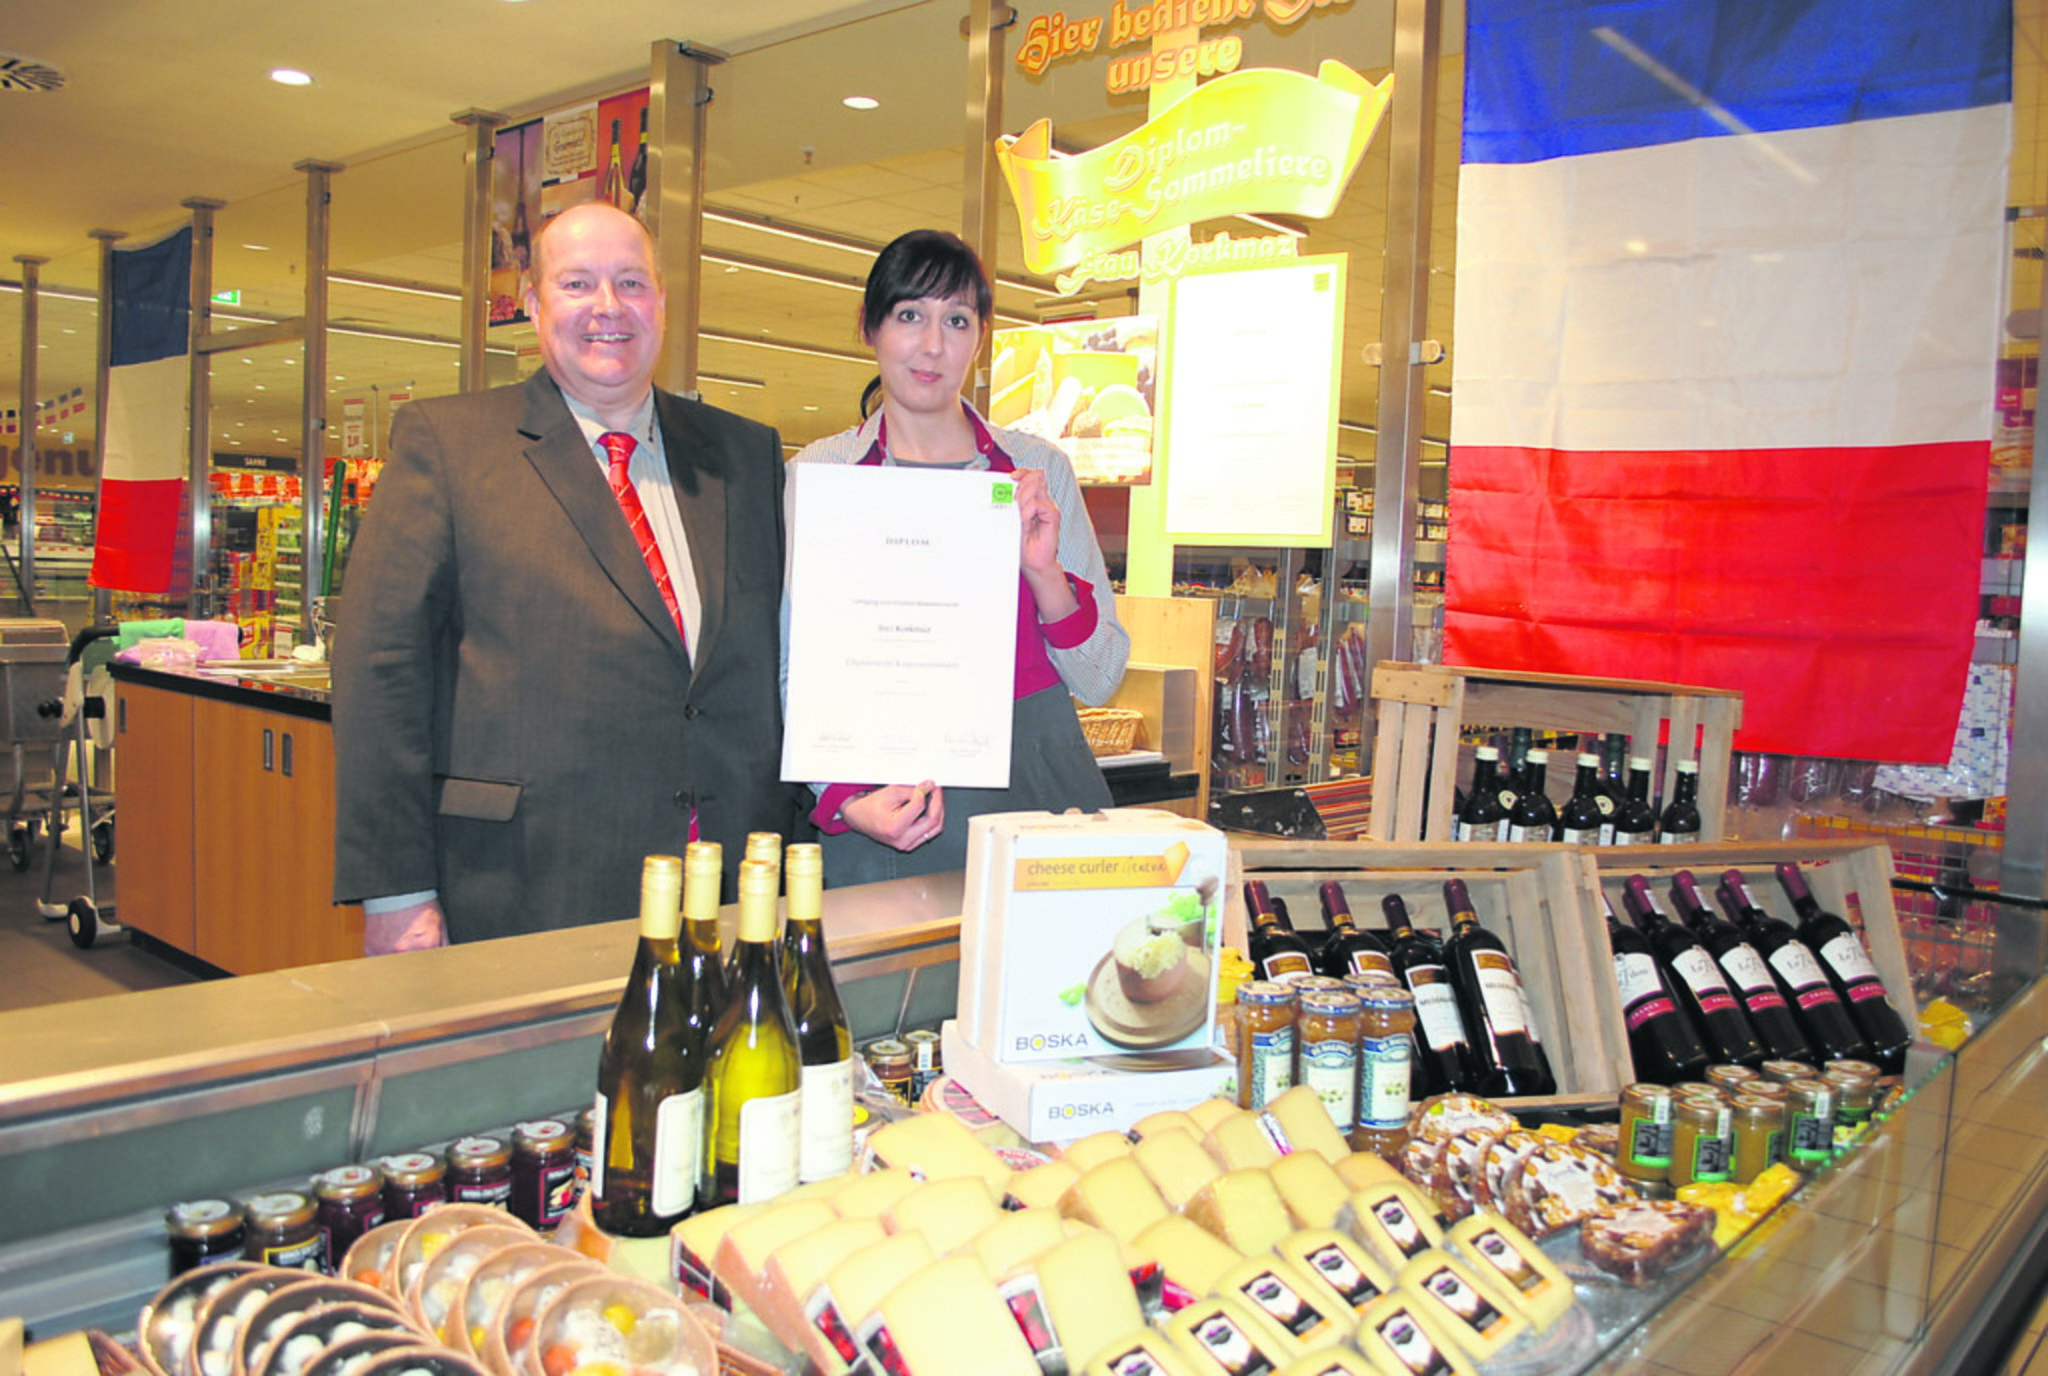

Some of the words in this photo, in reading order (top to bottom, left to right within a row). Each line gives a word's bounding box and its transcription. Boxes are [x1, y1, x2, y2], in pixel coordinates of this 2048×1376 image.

[1016, 14, 1103, 74] Hier
[1110, 0, 1256, 48] bedient
[1107, 36, 1242, 94] unsere
[1104, 119, 1248, 193] Diplom-
[1027, 862, 1076, 876] cheese
[1079, 859, 1119, 874] curler
[1015, 1033, 1088, 1052] BOSKA
[1048, 1101, 1114, 1120] BOSKA
